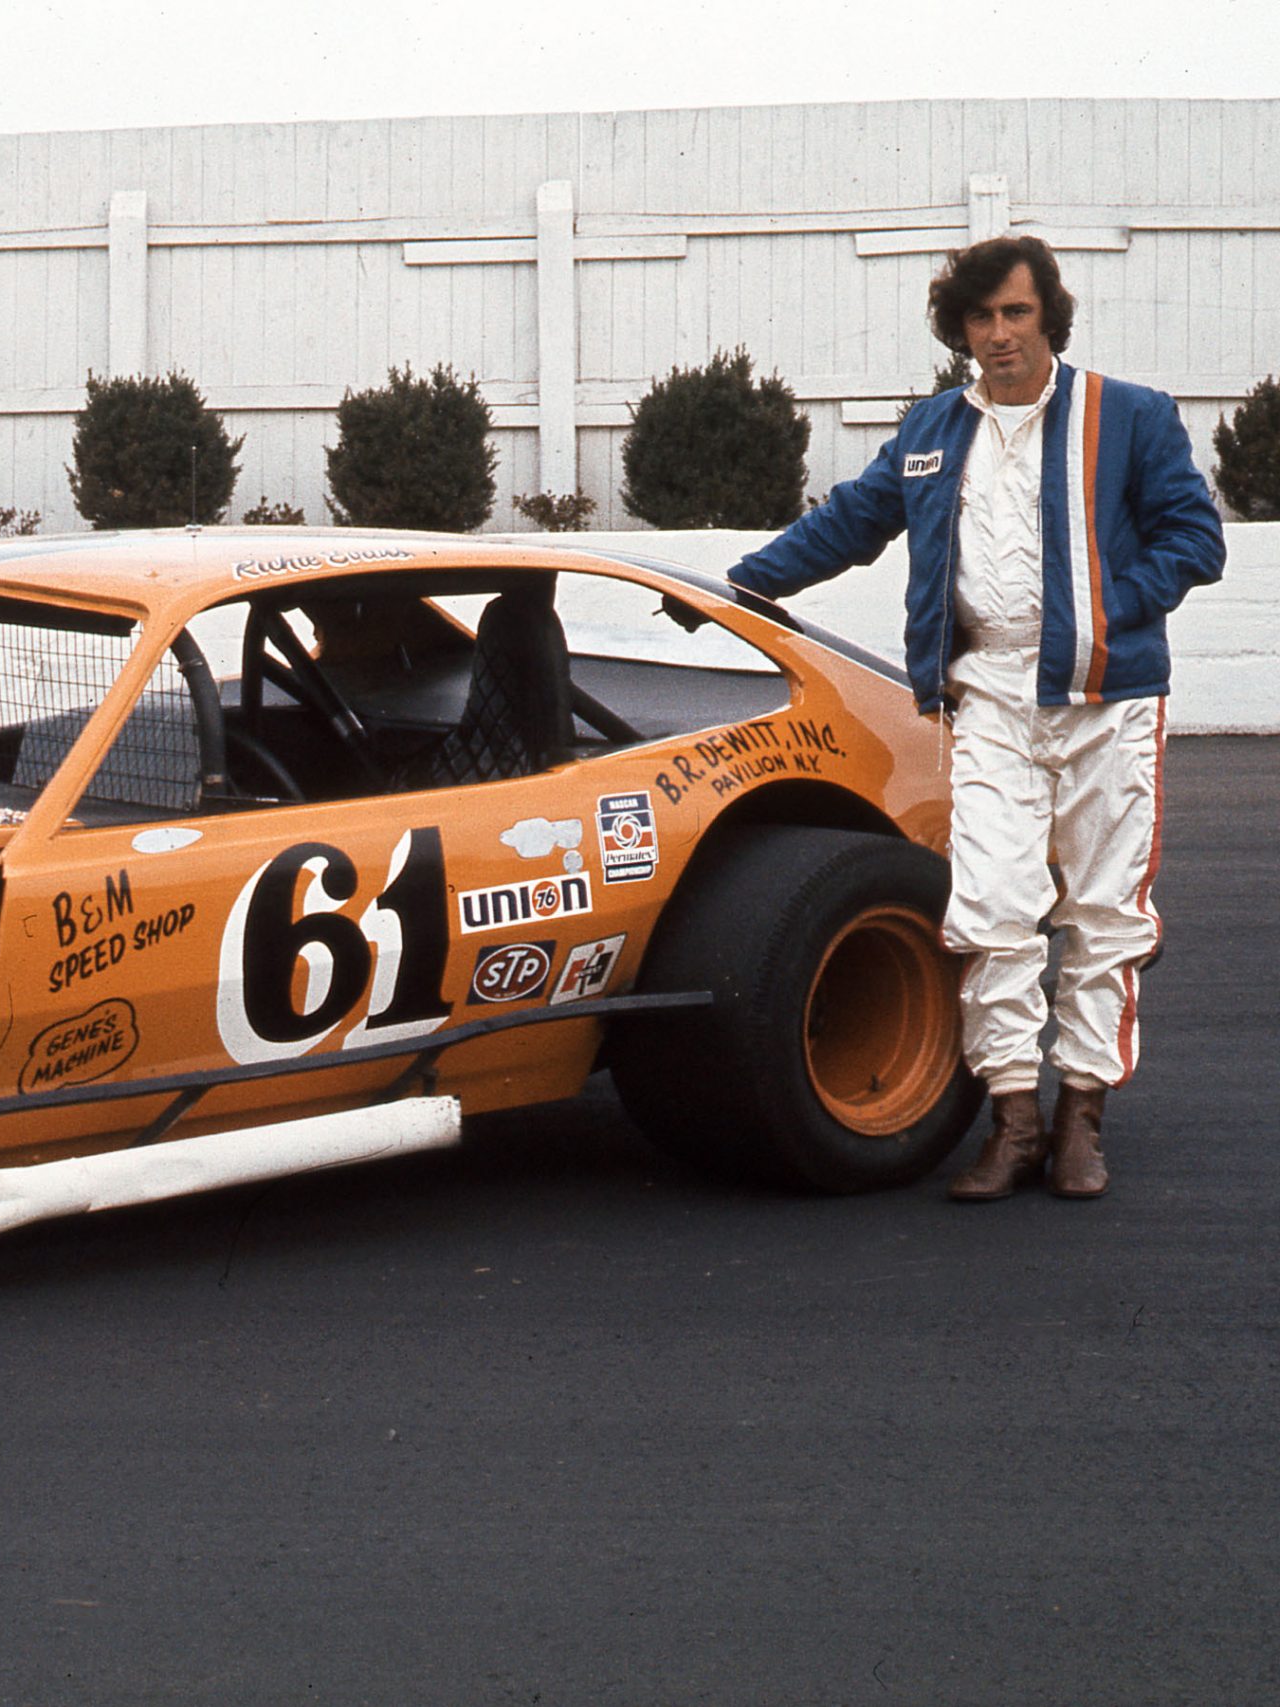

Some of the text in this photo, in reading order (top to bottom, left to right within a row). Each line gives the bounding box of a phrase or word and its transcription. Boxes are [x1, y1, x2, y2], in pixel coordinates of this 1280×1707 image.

[788, 719, 847, 759] INC.
[711, 753, 788, 797] PAVILION
[49, 903, 195, 993] SPEED SHOP
[217, 826, 455, 1065] 61
[483, 950, 540, 989] STP
[46, 1009, 117, 1056] GENE'S
[30, 1029, 124, 1088] MACHINE
